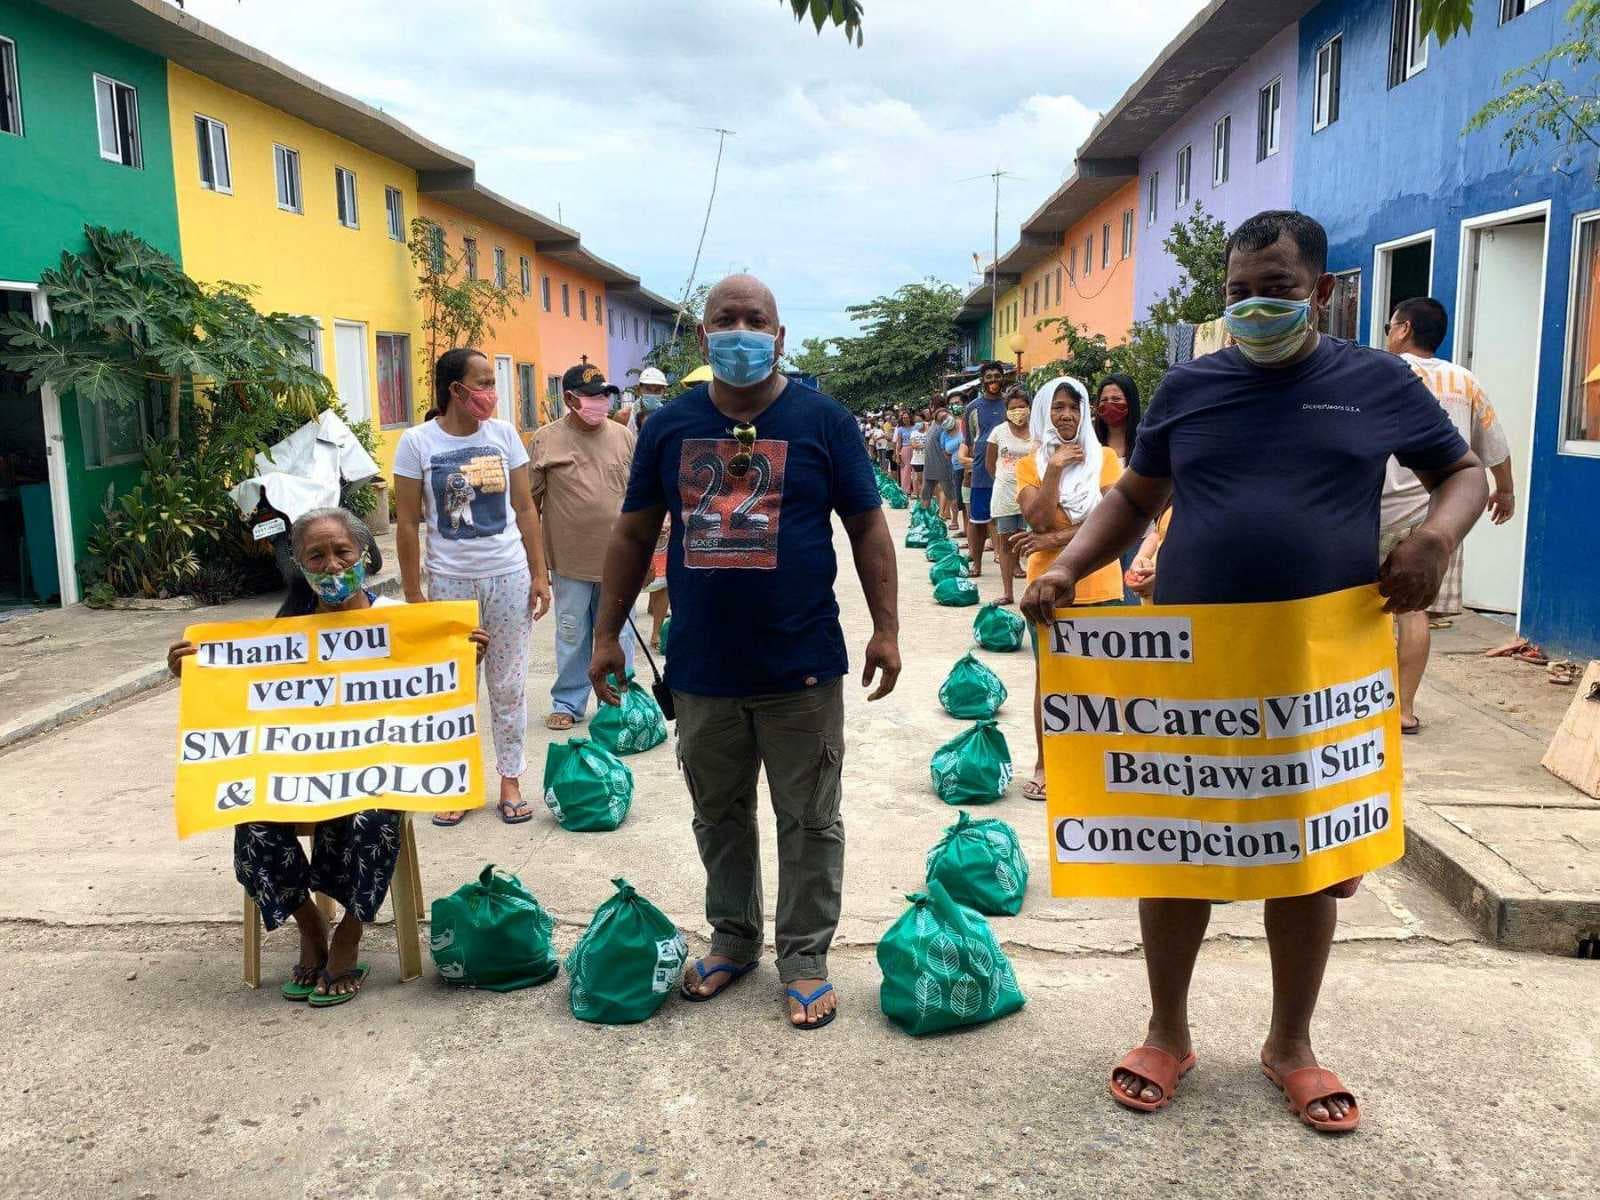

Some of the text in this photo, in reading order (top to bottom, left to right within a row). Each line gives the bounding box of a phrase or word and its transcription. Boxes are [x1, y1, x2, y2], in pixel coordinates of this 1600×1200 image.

[688, 452, 771, 530] 22
[200, 626, 387, 665] Thank you
[1052, 620, 1191, 659] From:
[252, 661, 457, 707] very much!
[1265, 679, 1395, 731] Village,
[183, 711, 476, 761] SM Foundation
[217, 763, 467, 811] & UNIQLO!
[1109, 738, 1385, 796] Bacjawan Sur,
[1055, 803, 1388, 864] Concepcion, Iloilo
